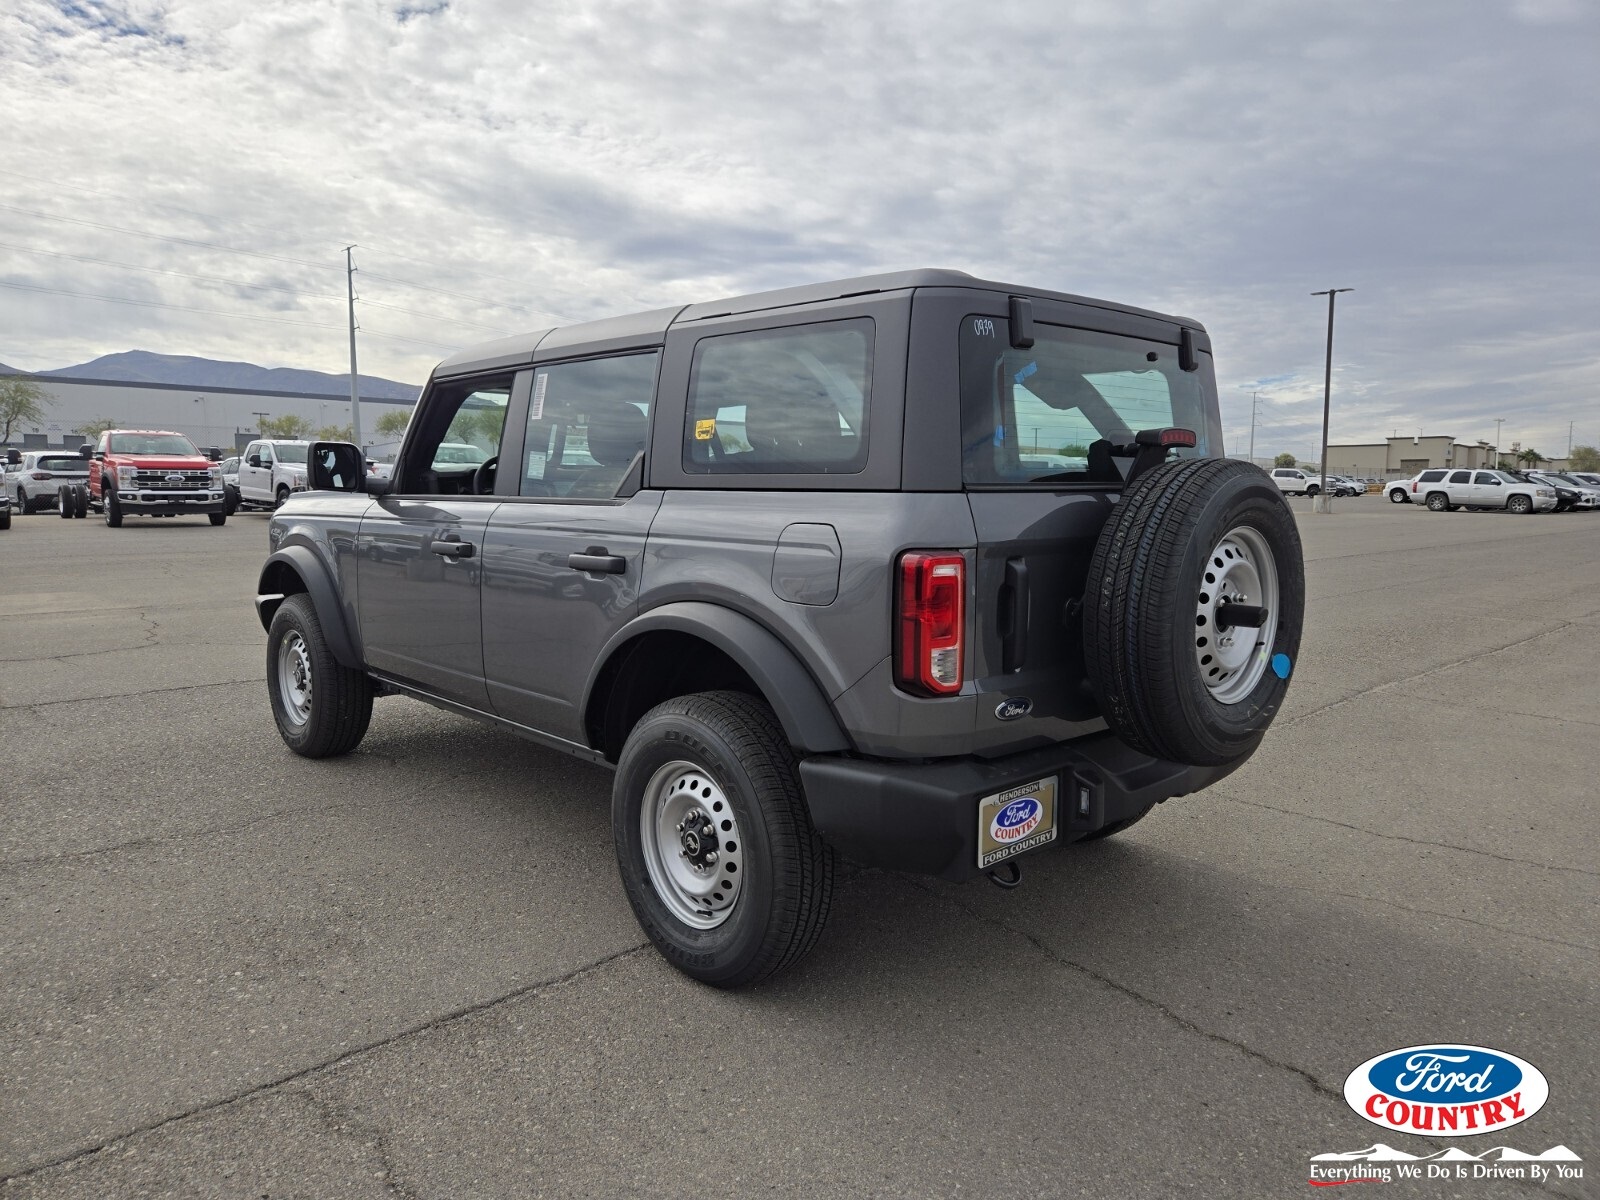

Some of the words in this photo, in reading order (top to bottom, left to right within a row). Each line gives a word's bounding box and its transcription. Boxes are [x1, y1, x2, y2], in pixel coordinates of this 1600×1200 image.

[1005, 704, 1025, 717] Ford
[1000, 783, 1039, 802] HENDERSON
[1004, 802, 1031, 826] Ford
[995, 813, 1038, 840] COUNTRY
[984, 848, 1009, 865] FORD
[1010, 832, 1052, 852] COUNTRY
